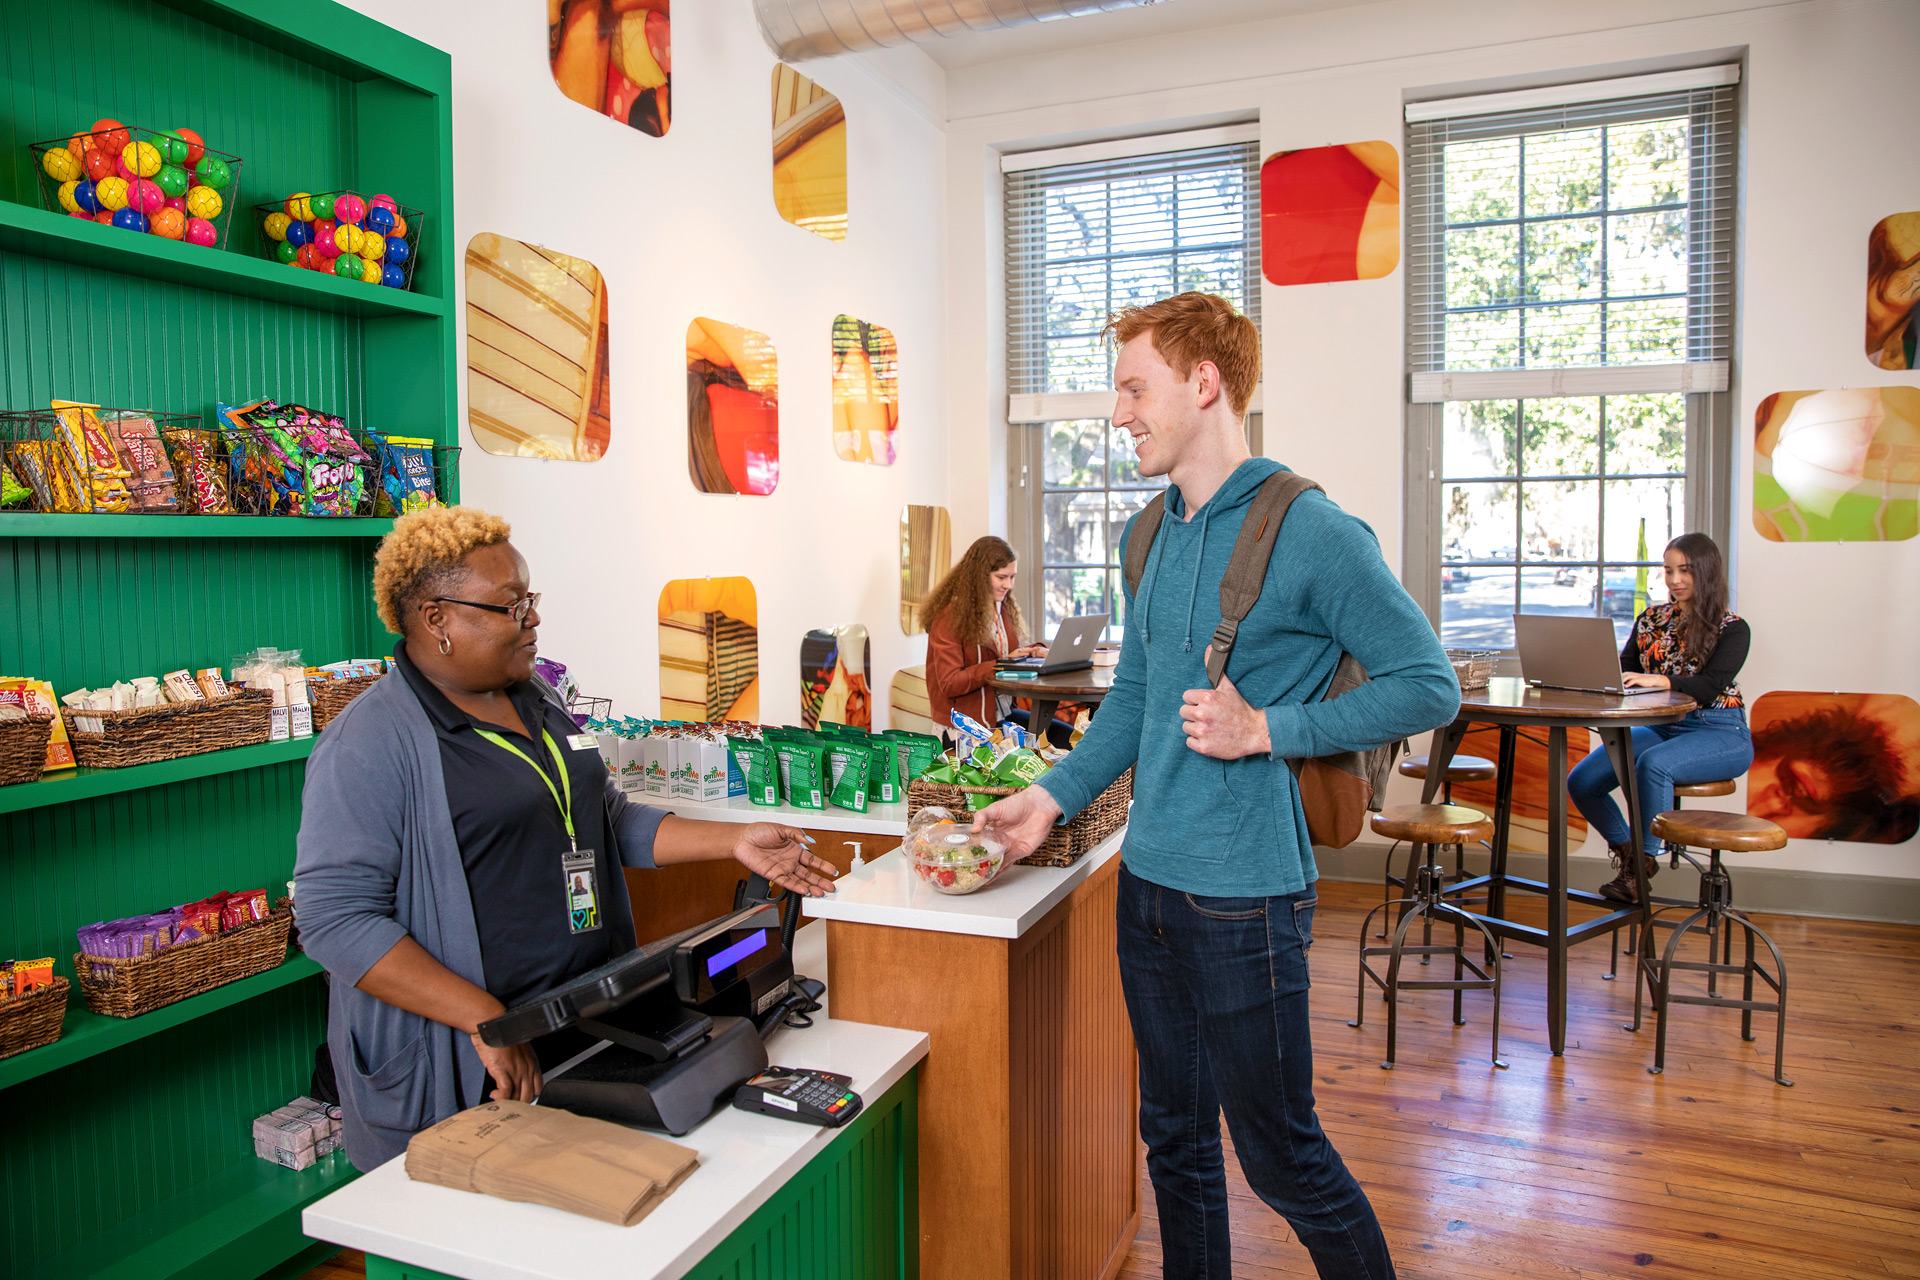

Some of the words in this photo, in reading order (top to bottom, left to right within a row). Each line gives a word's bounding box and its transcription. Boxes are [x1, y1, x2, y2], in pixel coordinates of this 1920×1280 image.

[121, 430, 149, 471] Wafers
[135, 431, 158, 470] Sugar
[181, 673, 206, 700] QUEST
[272, 708, 287, 716] MALVI
[292, 706, 310, 714] MALVI
